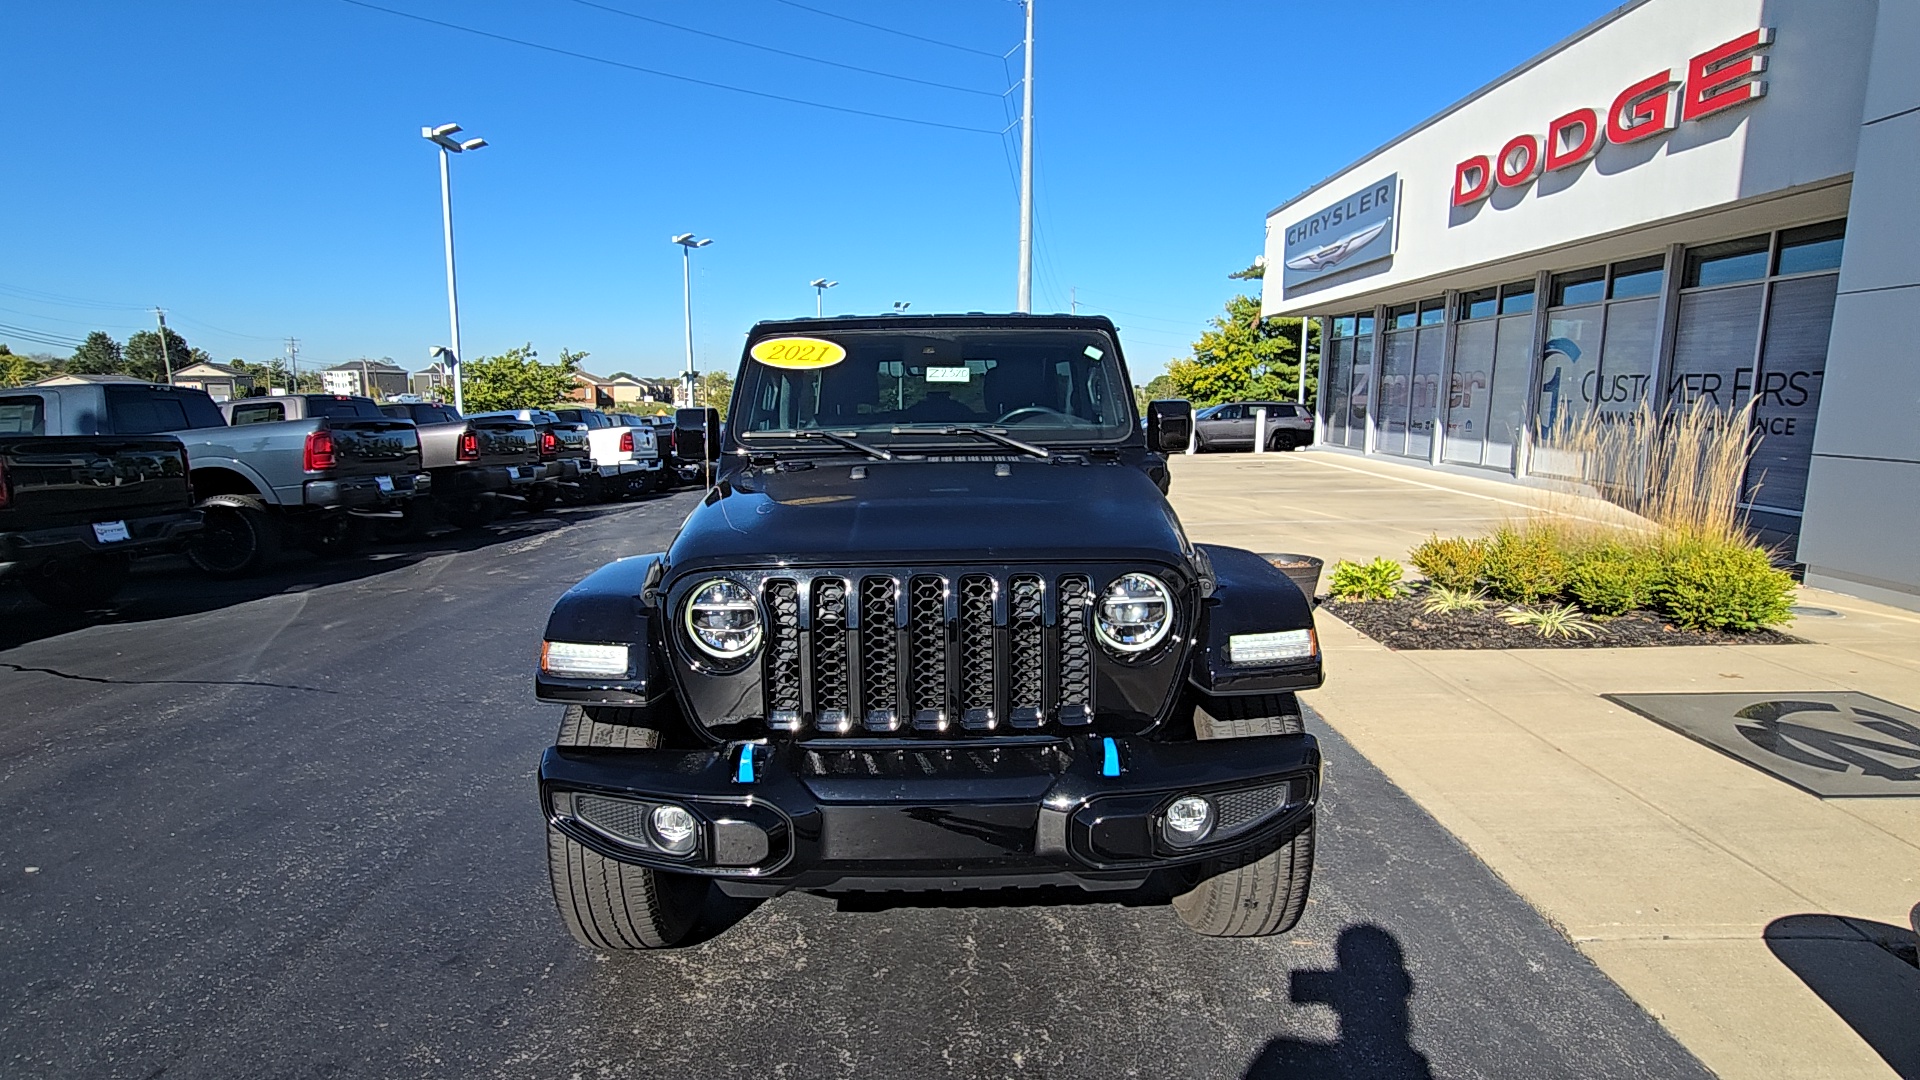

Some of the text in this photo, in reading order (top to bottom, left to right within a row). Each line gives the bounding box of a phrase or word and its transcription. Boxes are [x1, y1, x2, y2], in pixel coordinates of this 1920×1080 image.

[1453, 28, 1769, 207] DODGE
[1288, 184, 1390, 247] CHRYSLER
[766, 344, 830, 362] 2021
[1351, 364, 1486, 408] Zmmer
[1731, 367, 1825, 407] FRS
